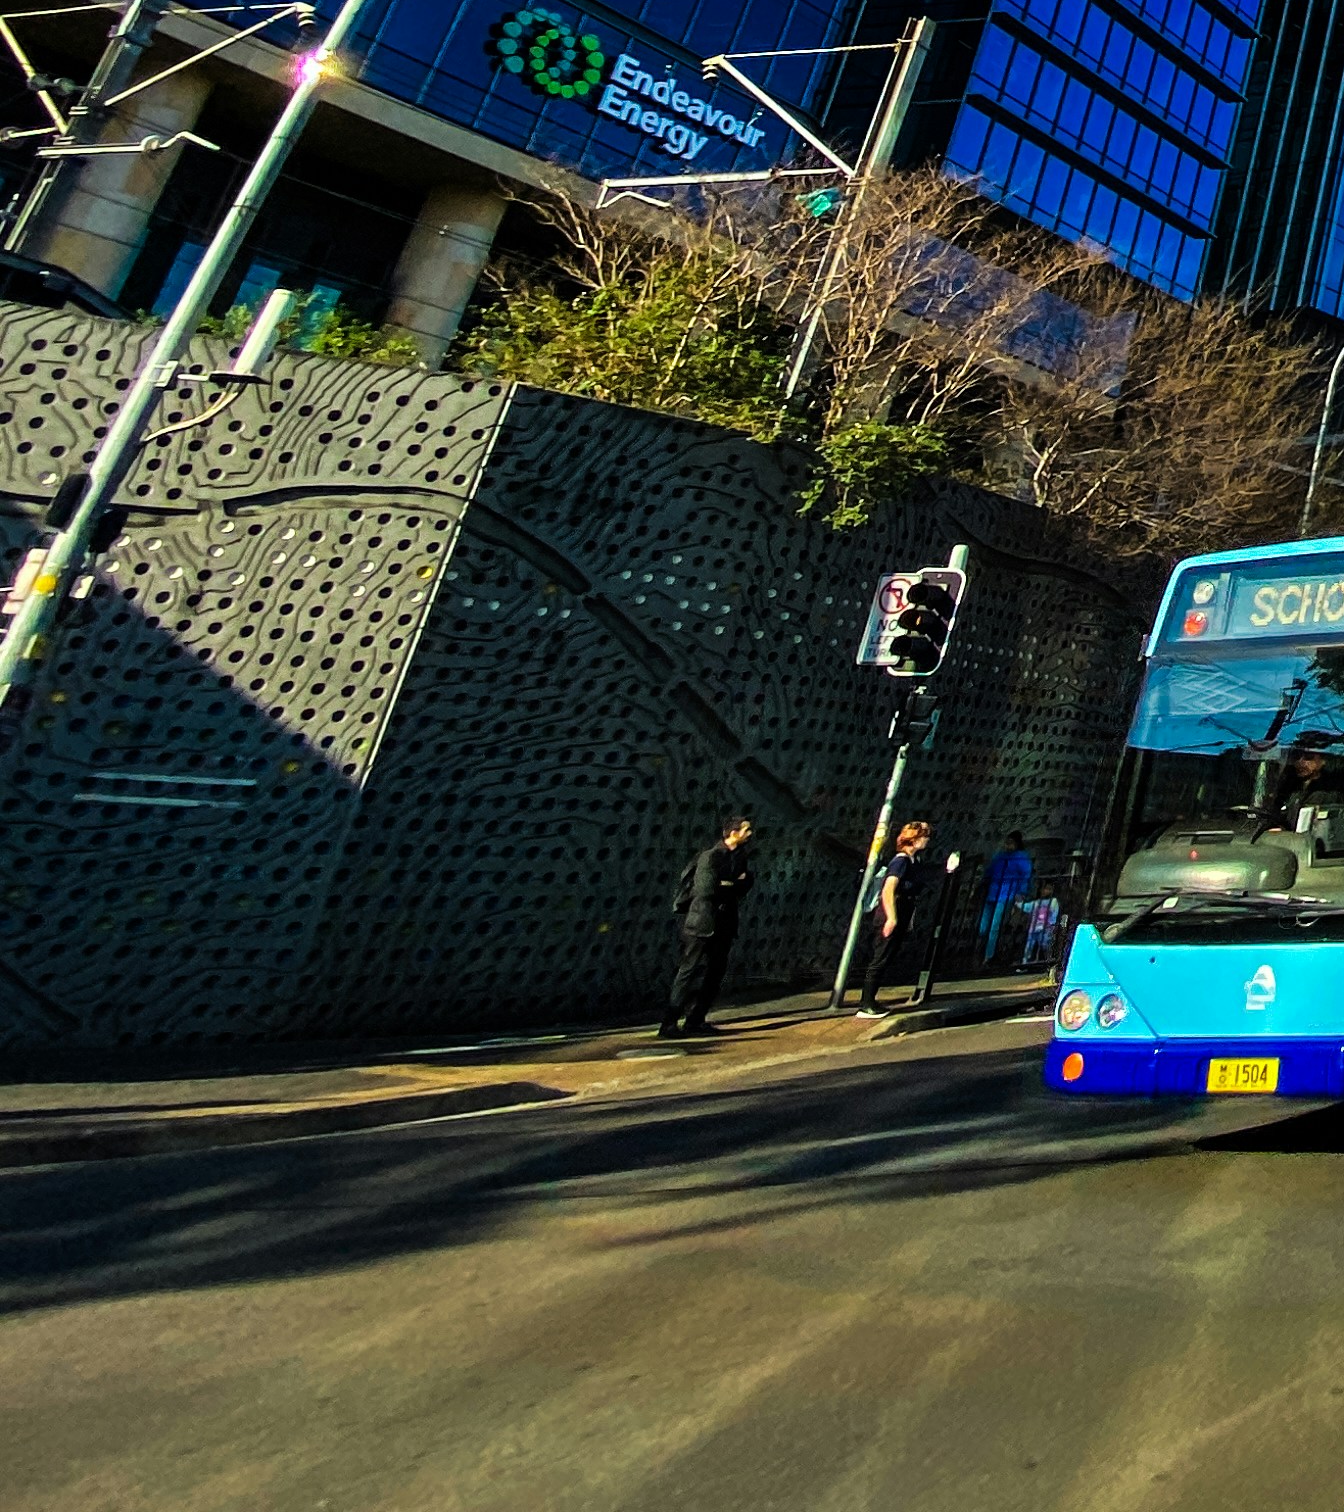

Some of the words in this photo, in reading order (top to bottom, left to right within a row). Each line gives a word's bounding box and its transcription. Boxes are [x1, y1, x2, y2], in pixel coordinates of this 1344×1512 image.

[597, 83, 709, 160] Energy
[611, 53, 766, 148] Endeavour
[877, 618, 899, 632] NO
[1234, 1063, 1269, 1085] 1504
